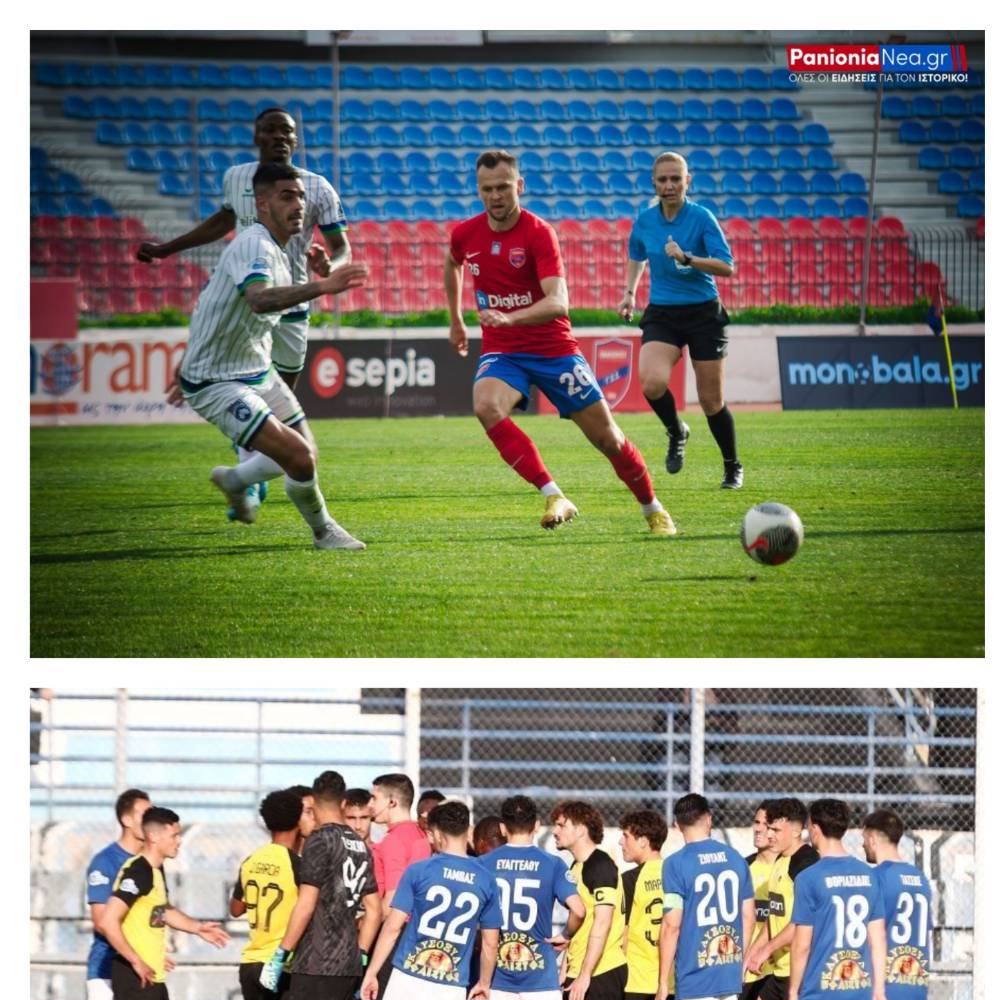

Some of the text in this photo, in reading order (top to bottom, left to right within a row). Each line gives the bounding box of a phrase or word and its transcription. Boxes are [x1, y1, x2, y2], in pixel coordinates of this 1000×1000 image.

[488, 292, 532, 309] Digital
[346, 347, 436, 396] sepia
[245, 880, 284, 933] 97
[417, 885, 480, 945] 22
[595, 890, 604, 902] C
[694, 869, 740, 927] 20
[832, 894, 869, 948] 18
[891, 892, 928, 947] 31
